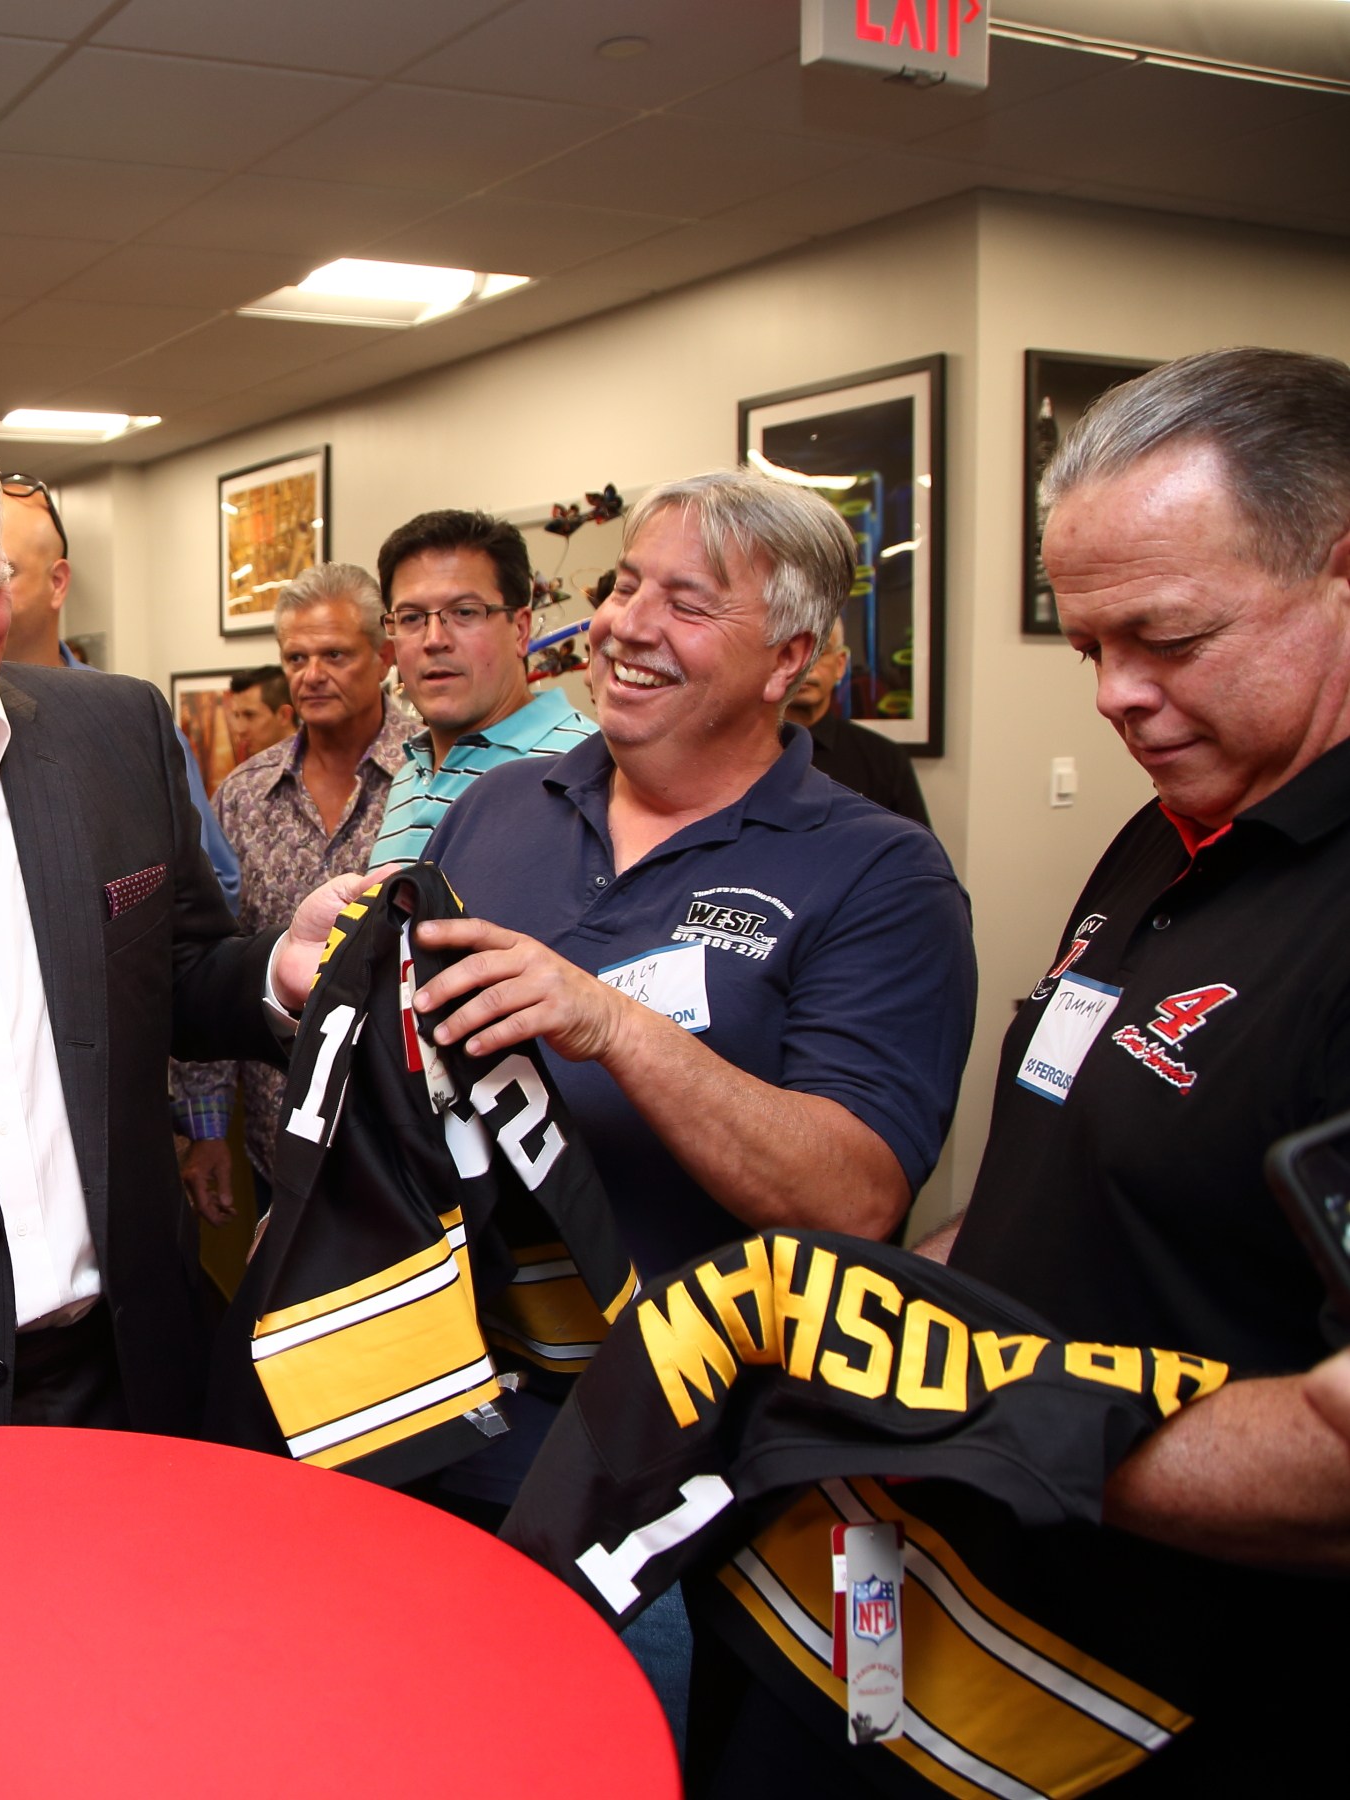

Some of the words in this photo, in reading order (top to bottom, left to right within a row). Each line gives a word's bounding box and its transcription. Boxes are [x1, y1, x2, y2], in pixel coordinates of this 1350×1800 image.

[686, 901, 768, 936] WEST
[285, 1004, 356, 1144] 1
[1146, 982, 1238, 1046] 4
[469, 1054, 569, 1192] 2
[637, 1234, 1230, 1428] BRADSHAW
[575, 1474, 734, 1615] 1
[858, 1600, 895, 1635] NFL
